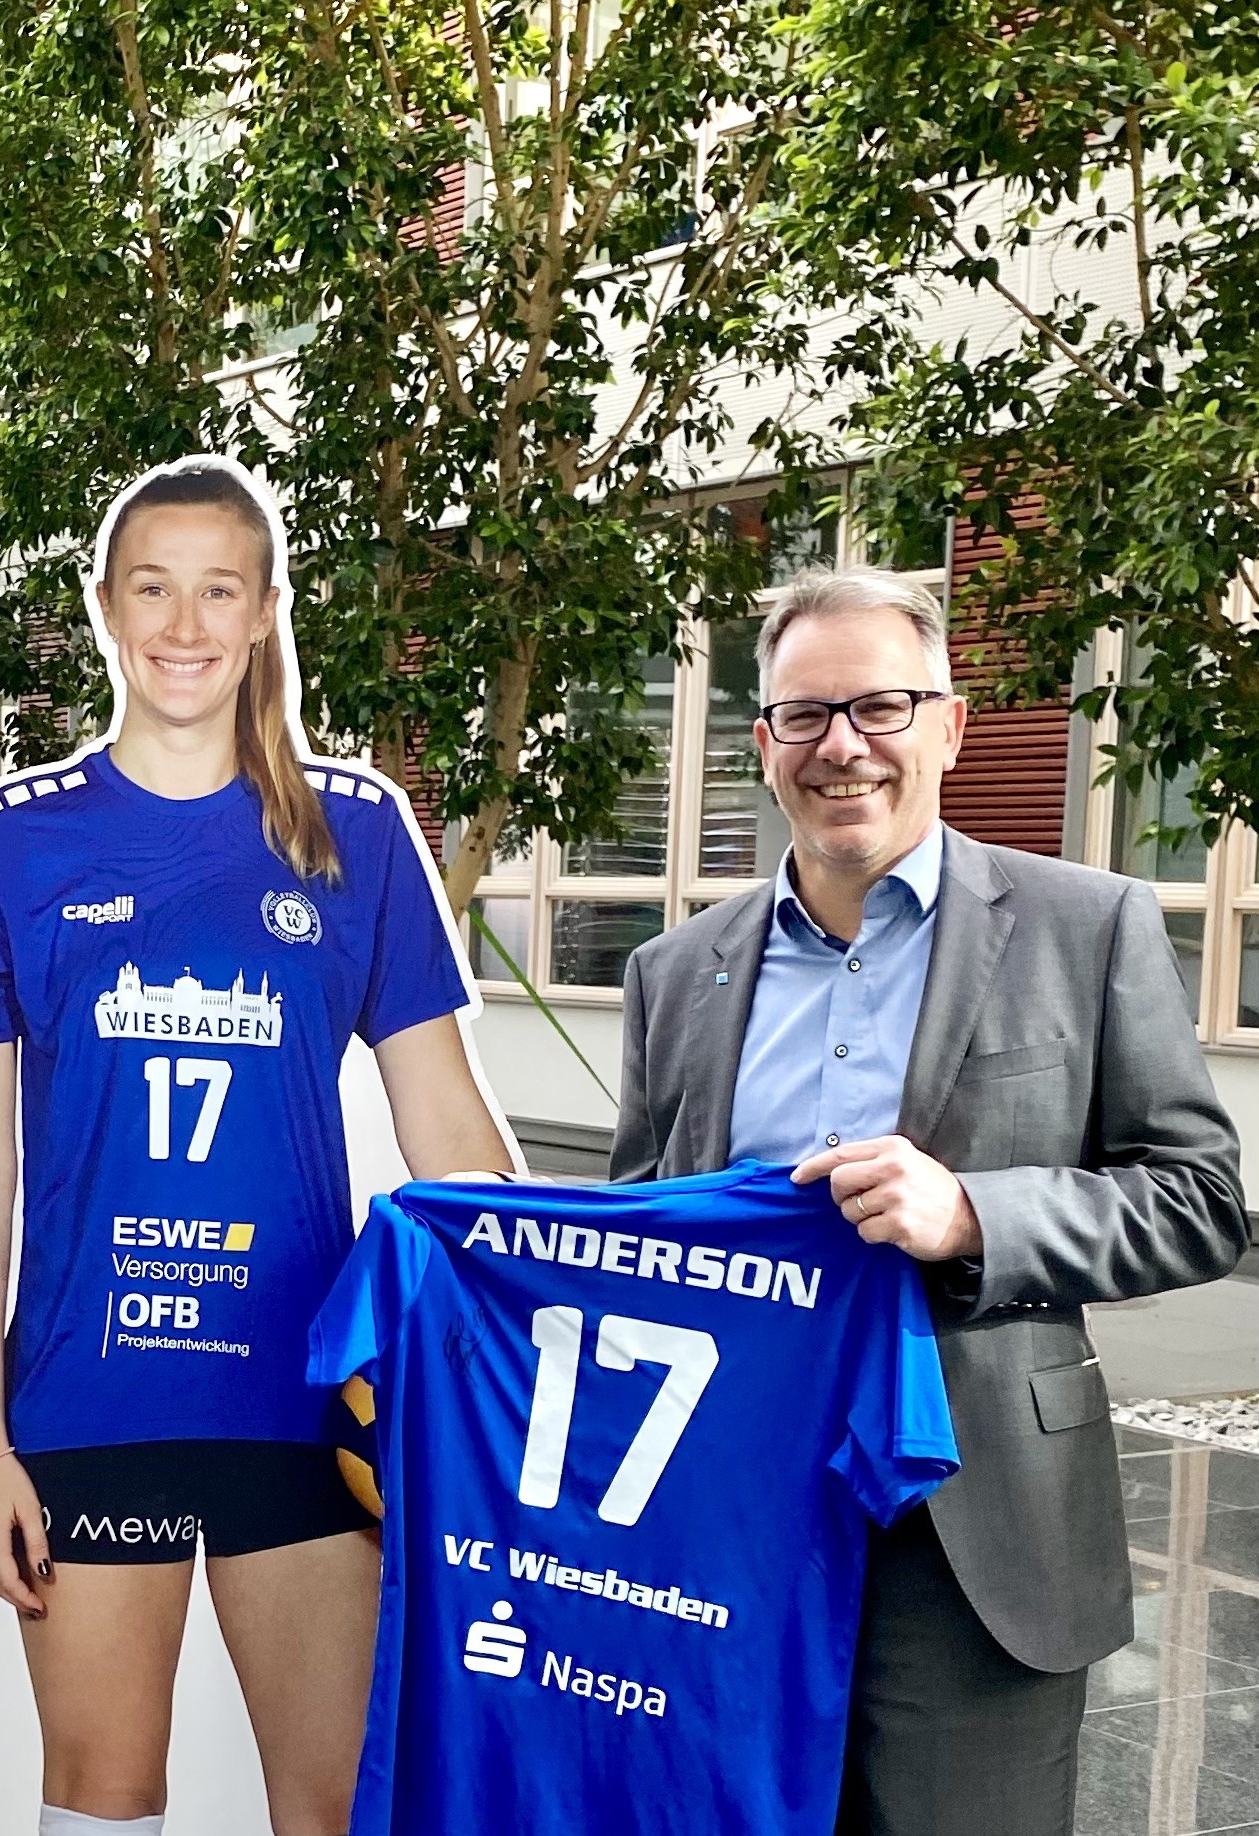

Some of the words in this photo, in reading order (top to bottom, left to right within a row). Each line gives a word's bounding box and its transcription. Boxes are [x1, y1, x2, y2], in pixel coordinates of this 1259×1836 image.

[62, 895, 134, 923] capelli
[106, 1011, 274, 1041] WIESBADEN
[144, 1057, 233, 1162] 17
[112, 1216, 222, 1250] ESWE
[111, 1252, 249, 1290] Versorgung
[462, 1212, 822, 1310] ANDERSON
[118, 1293, 200, 1329] OFB
[117, 1333, 250, 1357] Projektentwicklung
[518, 1305, 720, 1527] 17
[444, 1534, 494, 1573] VC
[509, 1547, 730, 1631] Wiesbaden
[541, 1650, 668, 1718] Naspa
